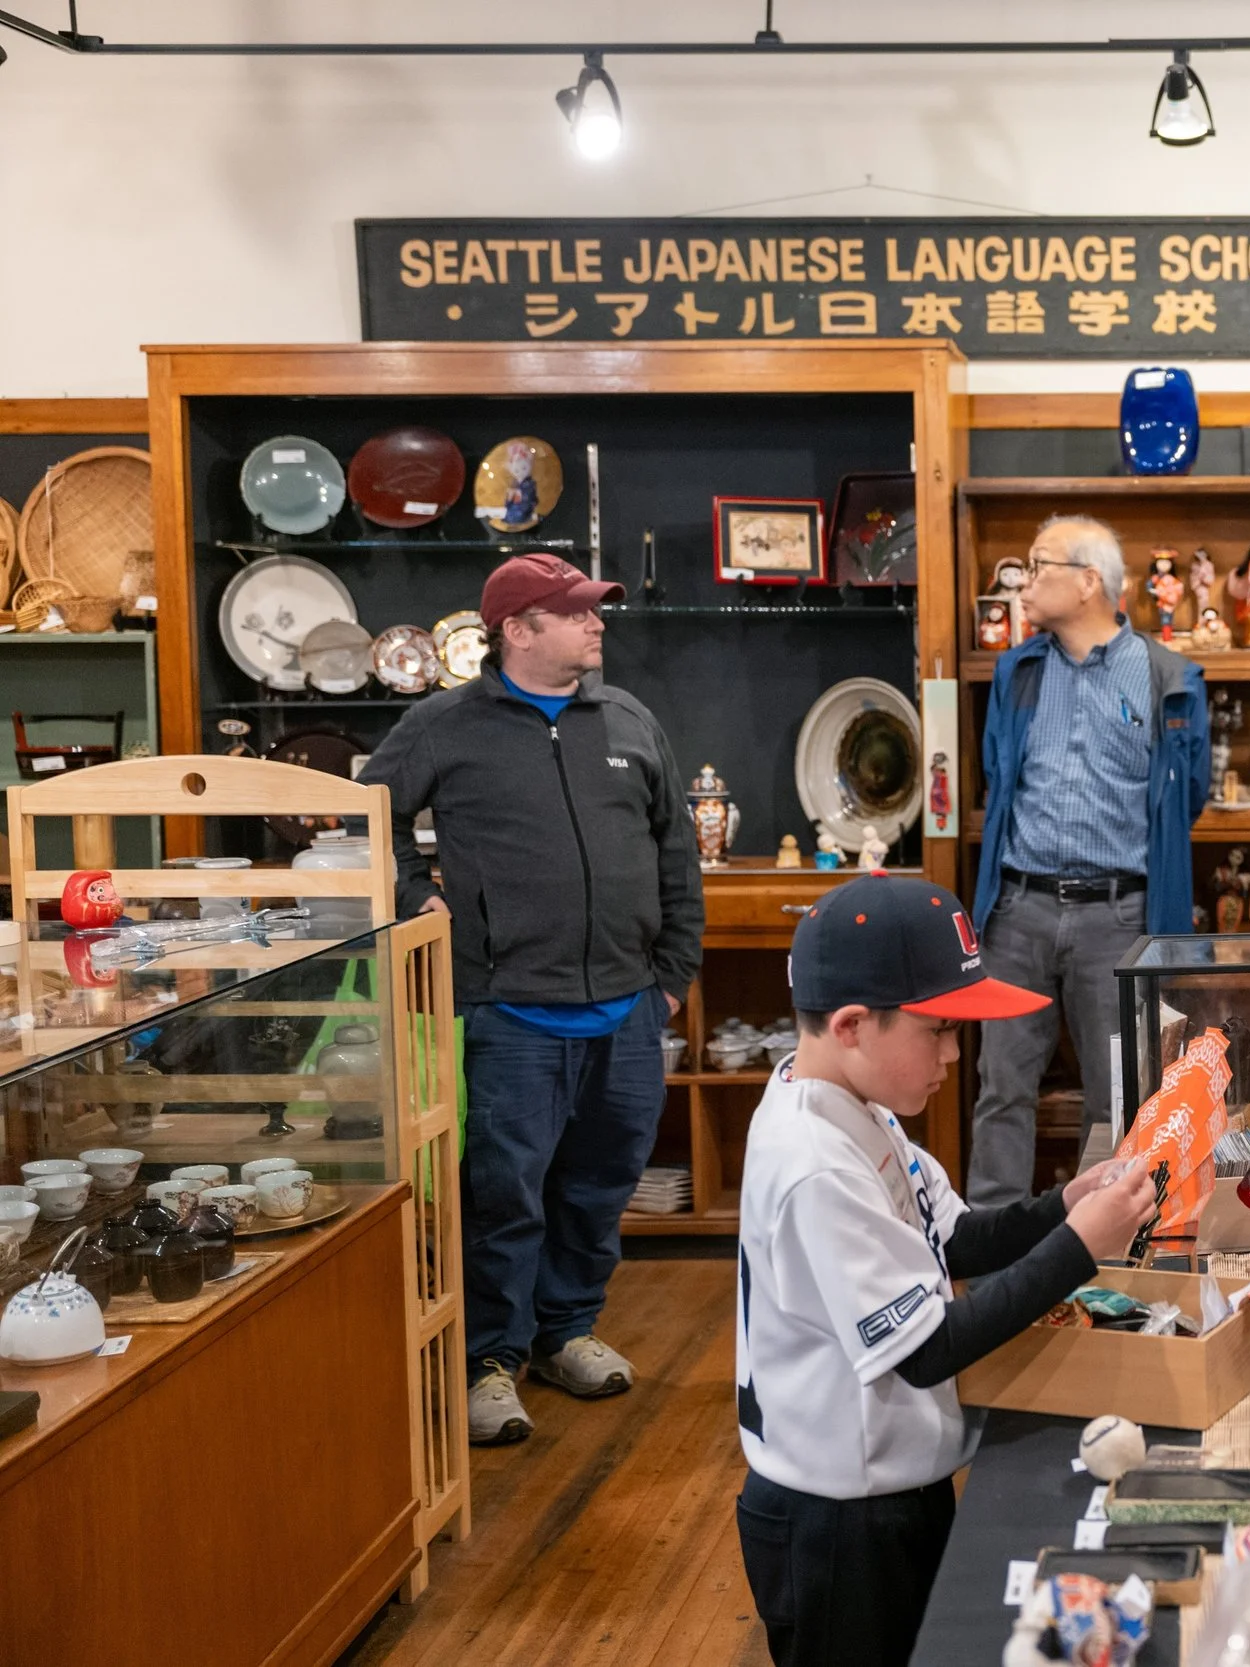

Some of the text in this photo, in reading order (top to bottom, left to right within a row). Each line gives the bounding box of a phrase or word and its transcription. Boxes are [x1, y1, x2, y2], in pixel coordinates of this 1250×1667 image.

[400, 239, 601, 285] SEATTLE
[624, 237, 865, 283] JAPANESE
[886, 235, 1137, 283] LANGUAGE
[525, 289, 1217, 338] シアトル日本語学校
[606, 756, 629, 768] VISA
